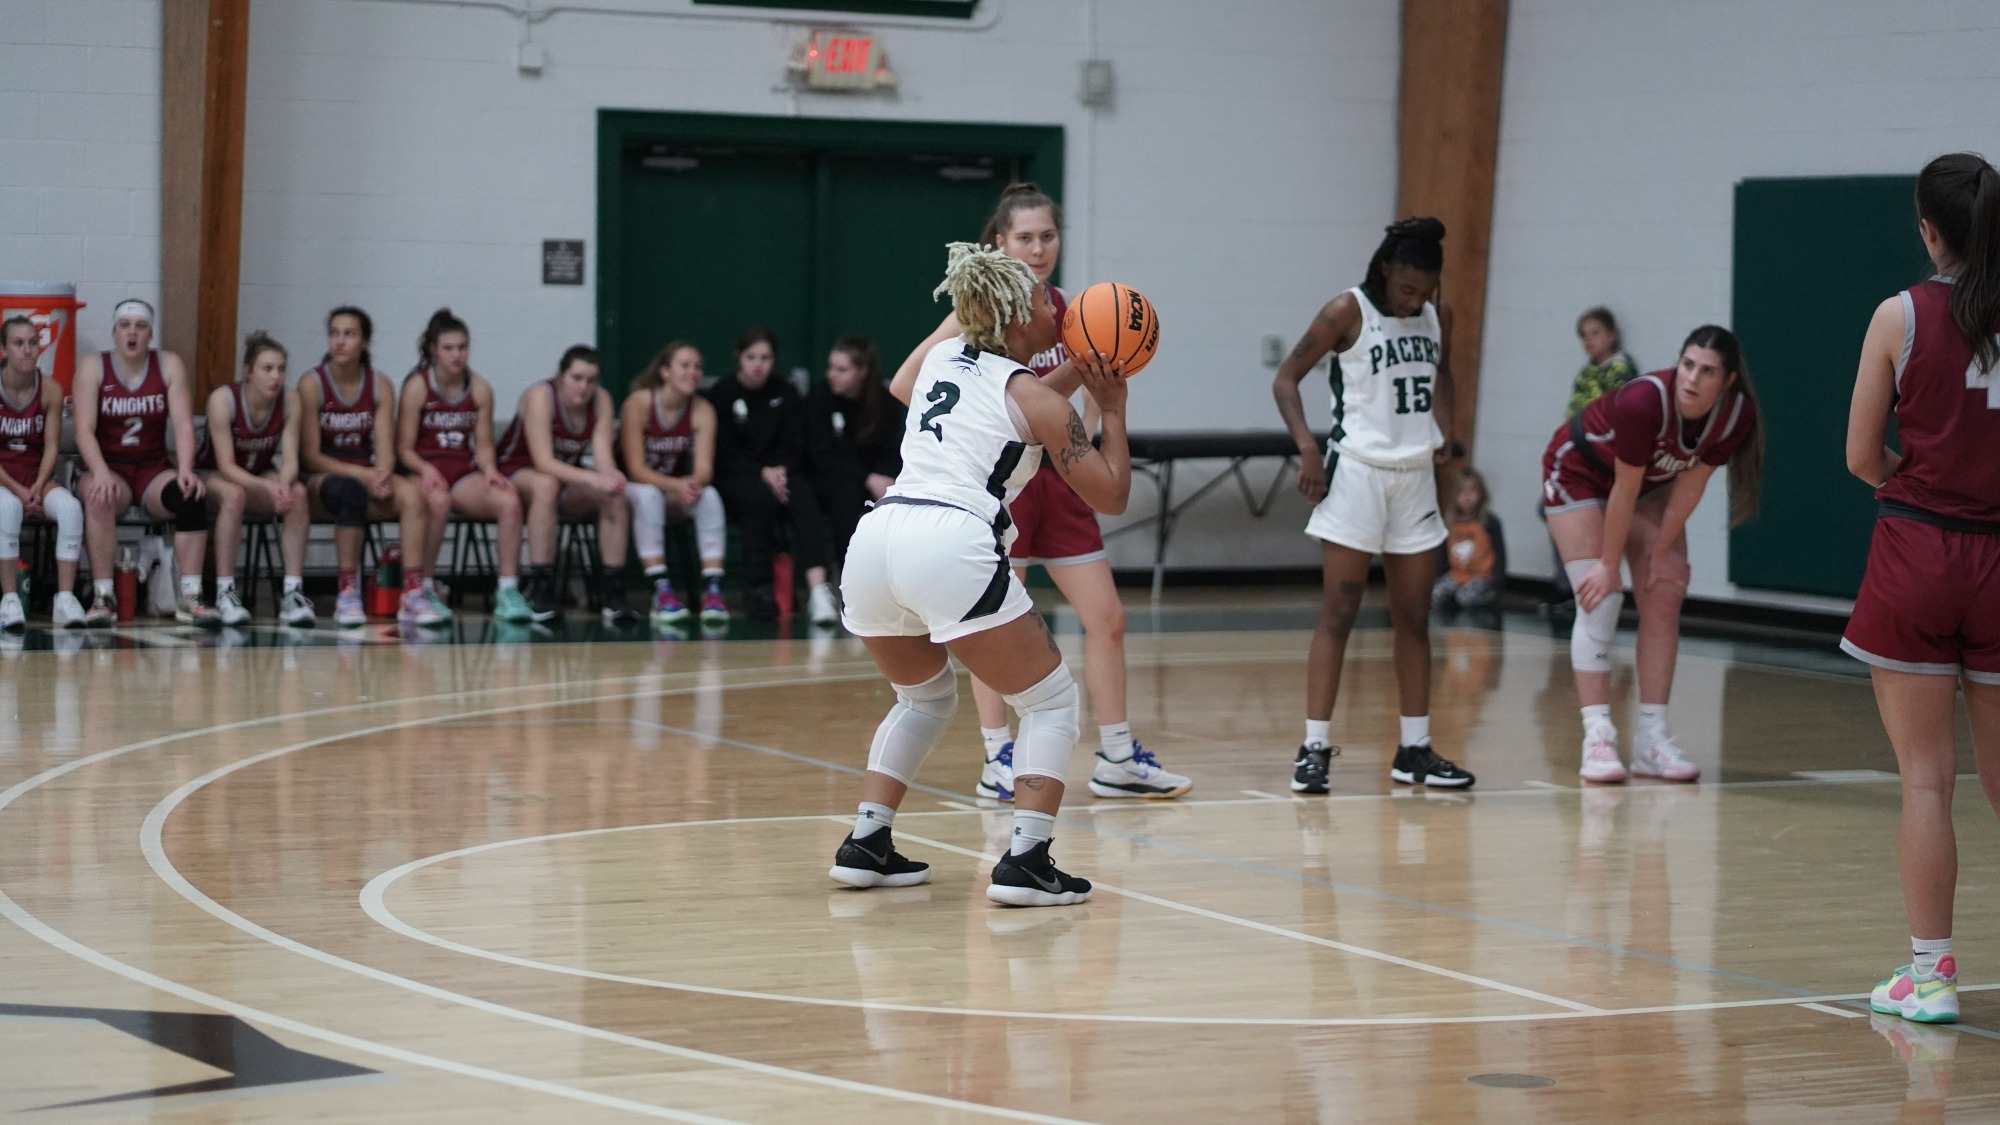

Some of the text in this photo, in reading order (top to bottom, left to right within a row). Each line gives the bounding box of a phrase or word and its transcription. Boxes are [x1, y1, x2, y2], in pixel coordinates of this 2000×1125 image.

[826, 38, 871, 74] EXIT
[1126, 289, 1144, 332] NCAA
[1028, 342, 1068, 369] IGHT
[101, 394, 165, 416] KNIGHTS
[919, 380, 961, 443] 2
[1393, 376, 1431, 414] 15
[121, 417, 143, 447] 2
